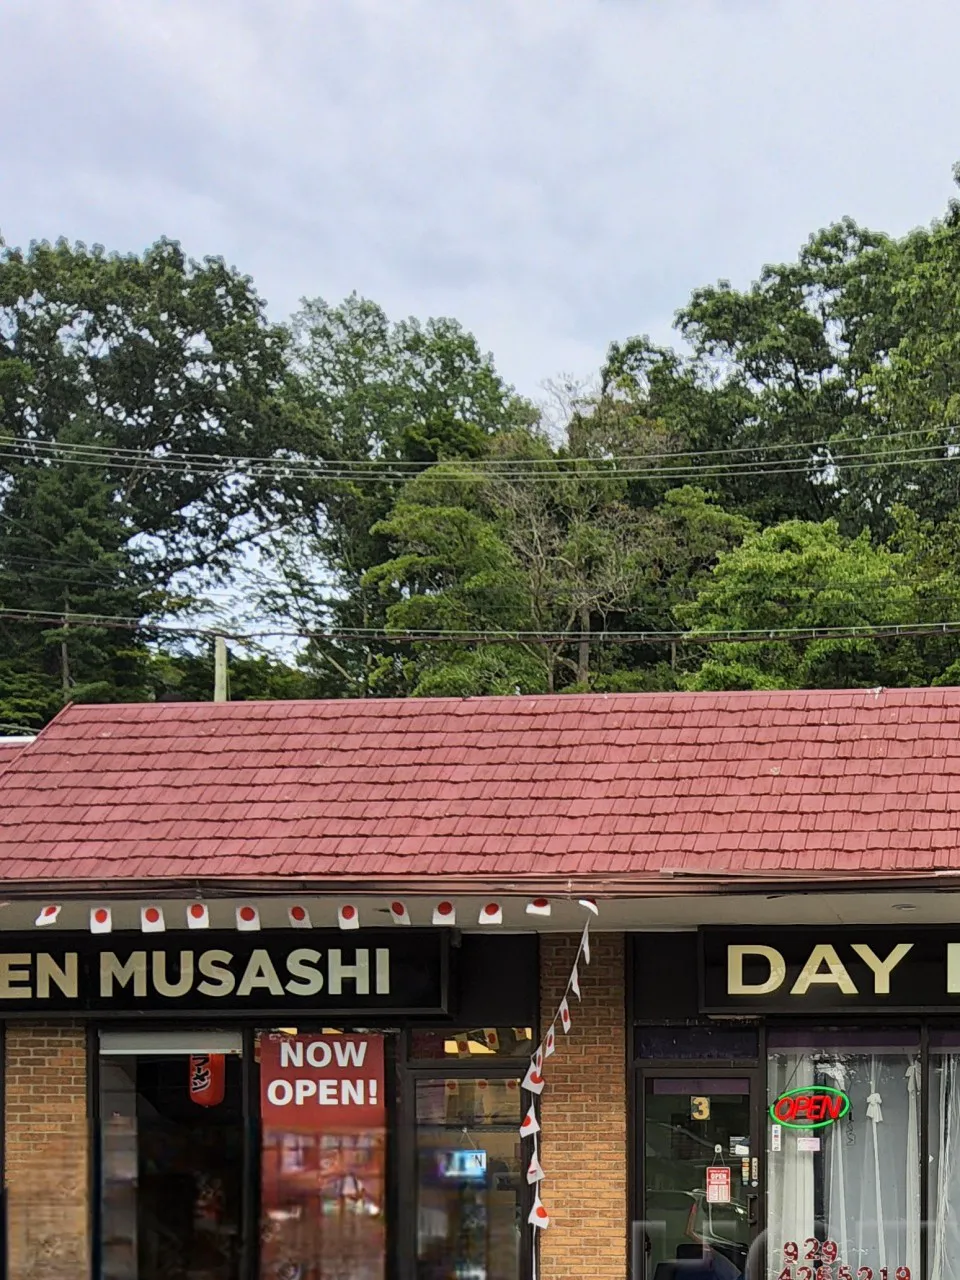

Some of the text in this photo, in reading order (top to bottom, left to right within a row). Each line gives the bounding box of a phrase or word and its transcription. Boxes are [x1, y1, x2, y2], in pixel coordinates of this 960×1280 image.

[0, 948, 390, 999] EN MUSASHI
[727, 943, 914, 994] DAY
[280, 1041, 368, 1068] NOW
[266, 1079, 378, 1106] OPEN!
[692, 1096, 711, 1120] 3
[774, 1095, 843, 1122] OPEN
[783, 1237, 838, 1265] 929
